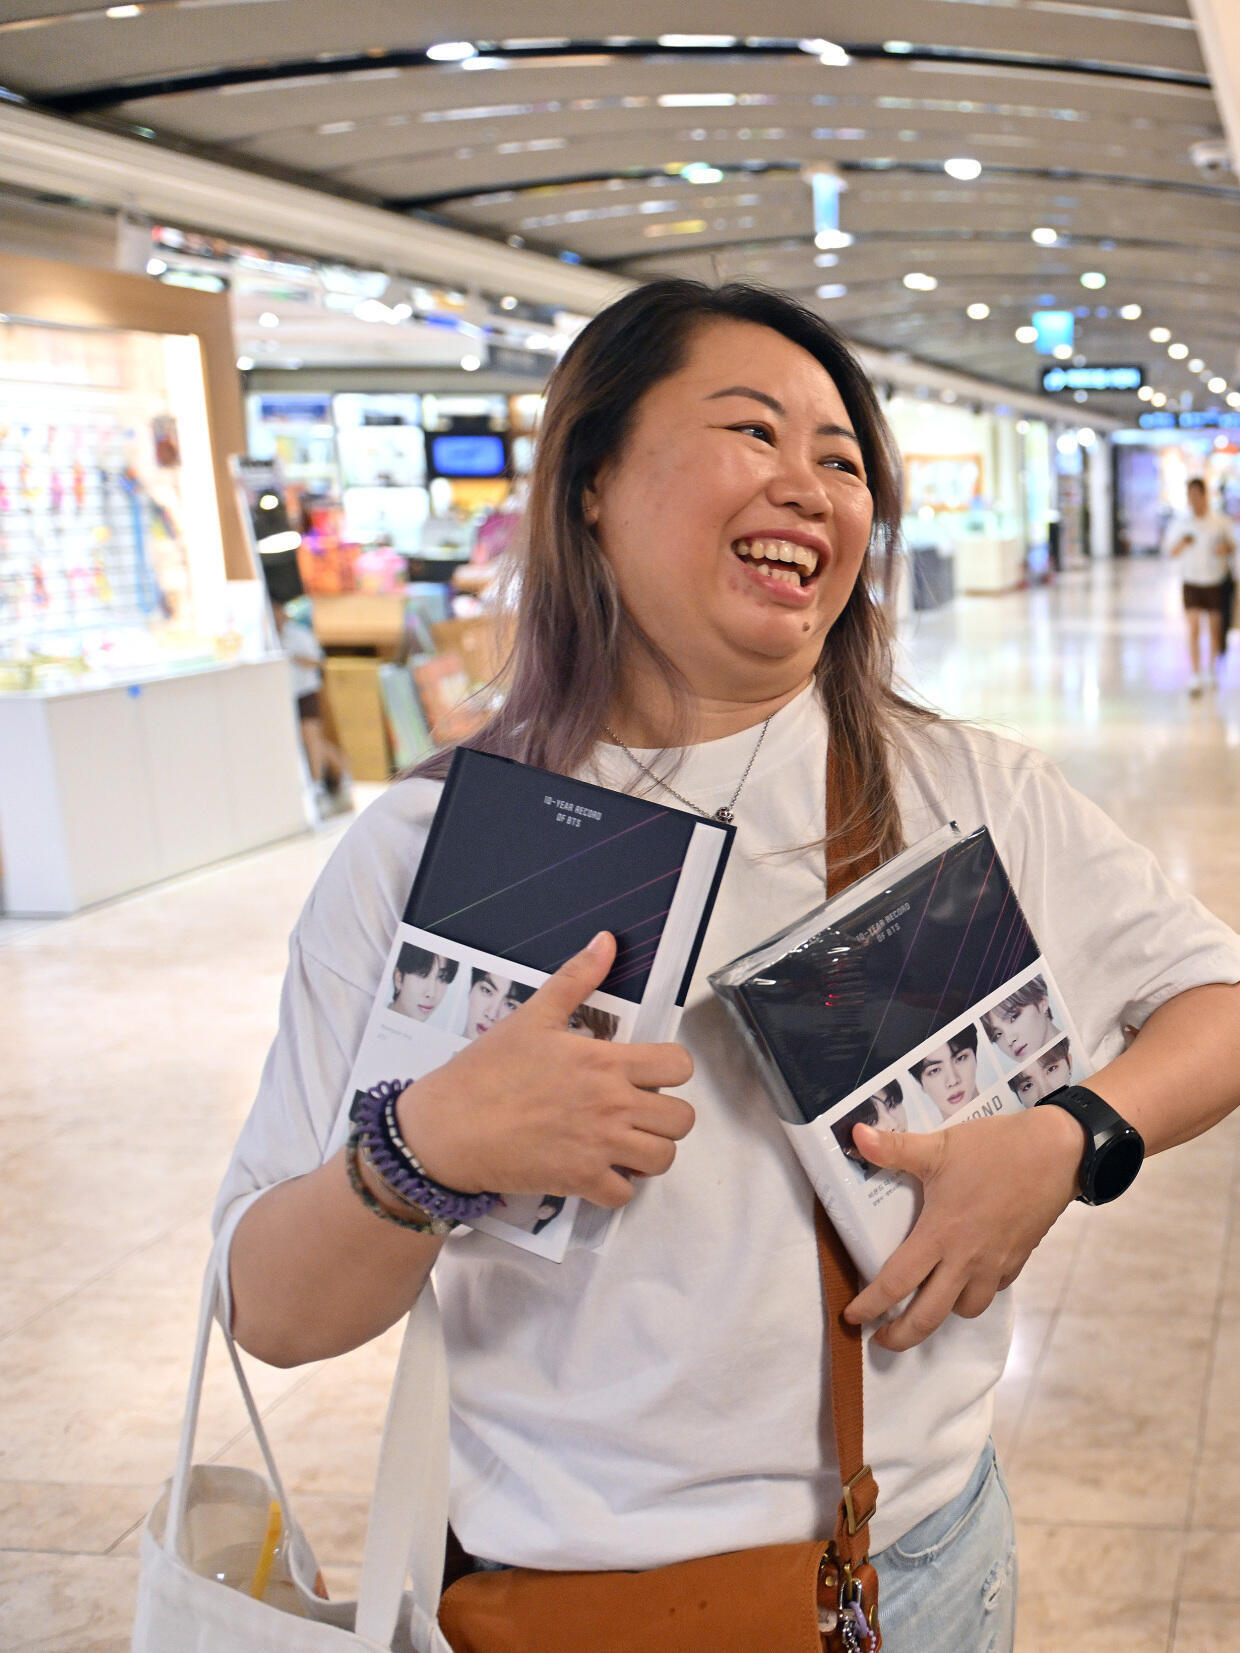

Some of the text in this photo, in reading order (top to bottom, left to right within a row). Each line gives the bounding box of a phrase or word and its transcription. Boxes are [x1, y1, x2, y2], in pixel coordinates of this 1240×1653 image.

[544, 796, 602, 820] 10-YEAR RECORD
[556, 813, 581, 827] OF BTS
[855, 902, 911, 943] 10-YEAR RECORD
[876, 922, 901, 943] OF BTS
[967, 1095, 1003, 1121] OND
